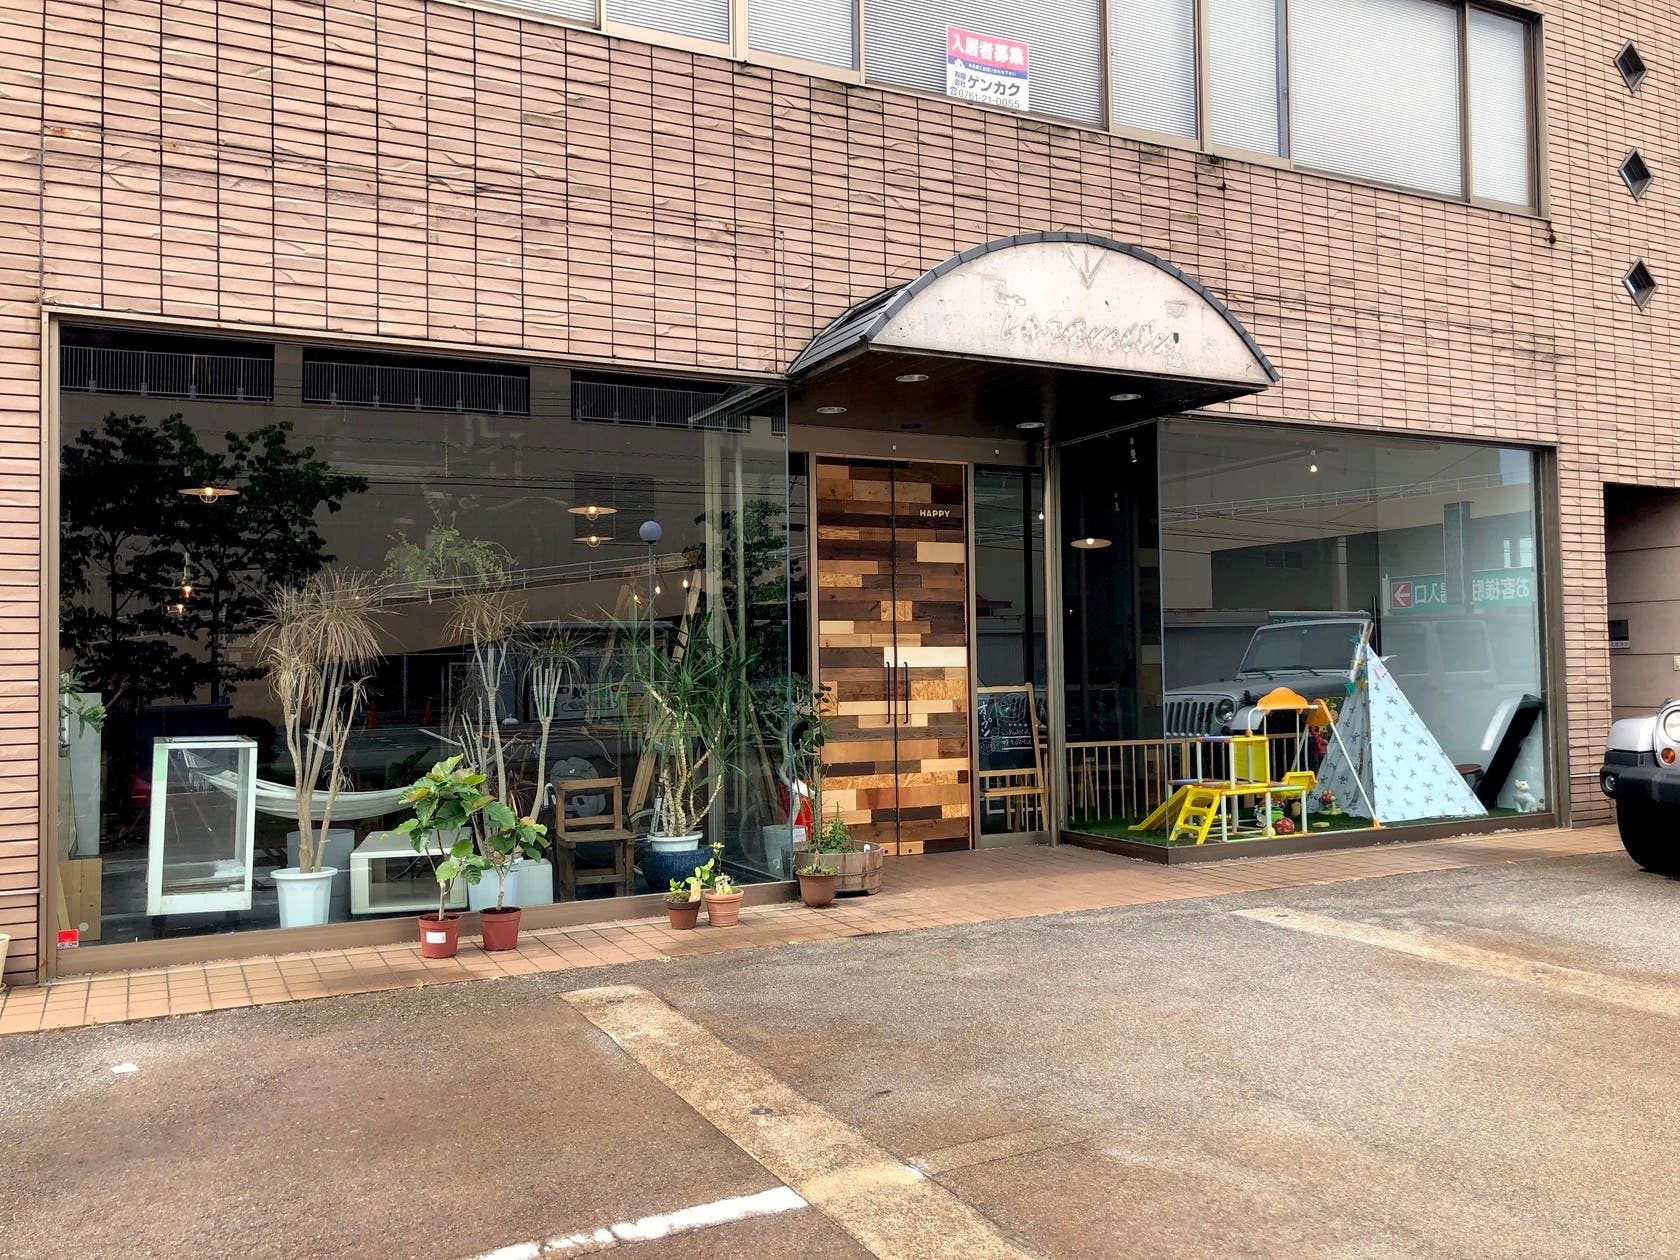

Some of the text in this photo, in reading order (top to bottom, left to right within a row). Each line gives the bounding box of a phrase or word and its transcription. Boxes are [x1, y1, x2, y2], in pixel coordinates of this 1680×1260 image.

[951, 33, 1024, 66] 入居者募集
[967, 75, 1020, 97] ゲンカク
[958, 89, 1020, 109] 0761-21-0055
[919, 509, 951, 518] HAPPY
